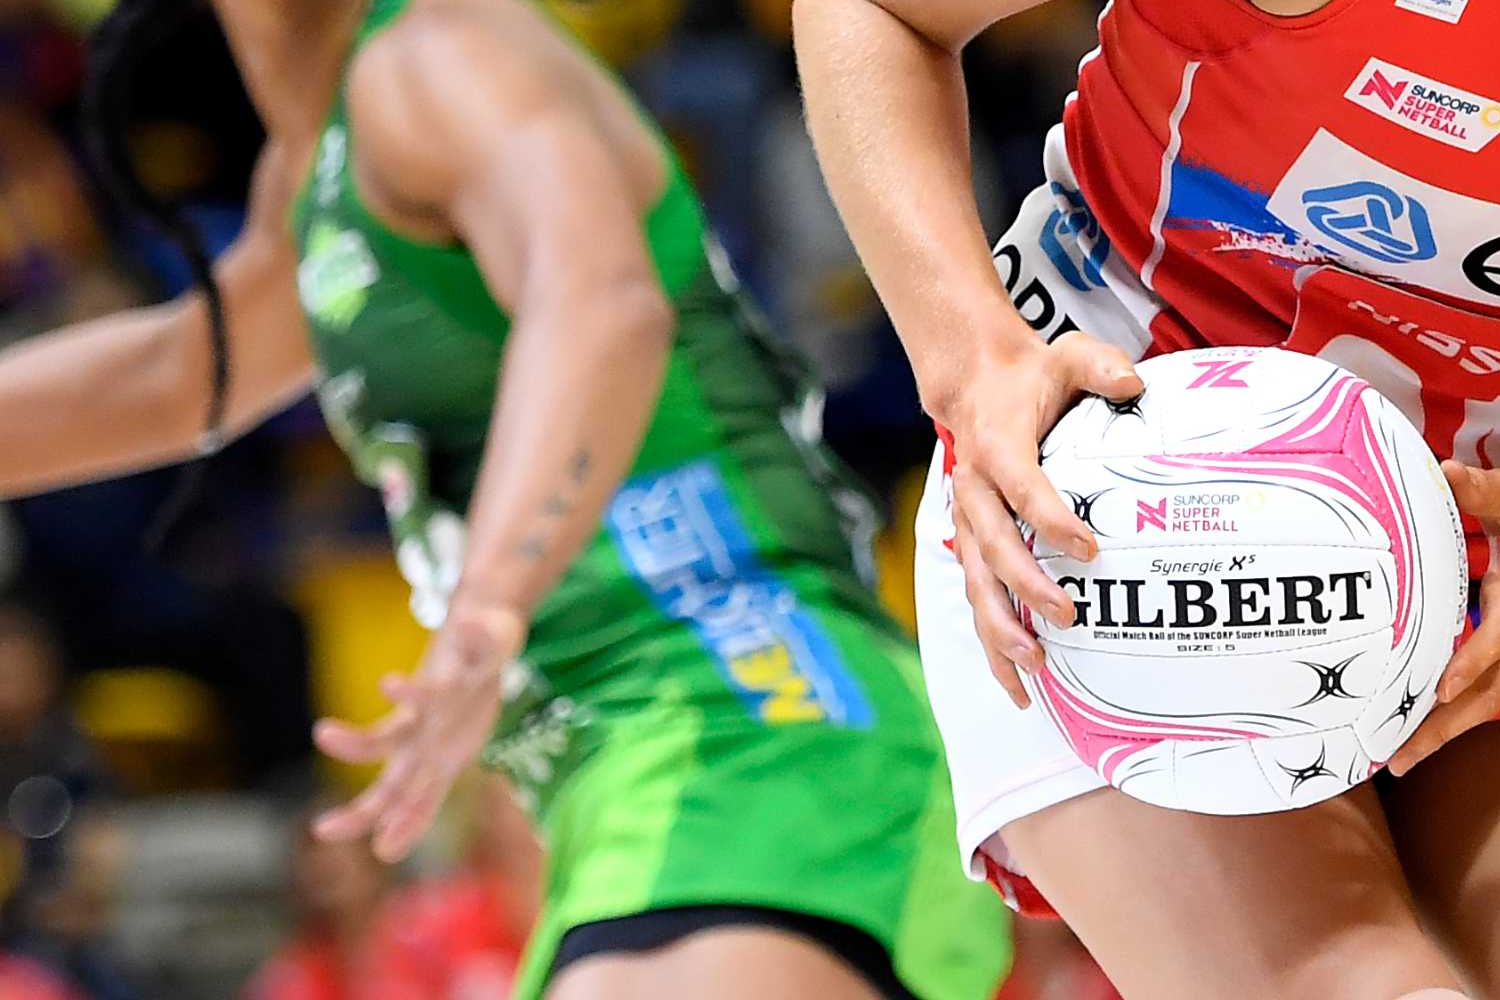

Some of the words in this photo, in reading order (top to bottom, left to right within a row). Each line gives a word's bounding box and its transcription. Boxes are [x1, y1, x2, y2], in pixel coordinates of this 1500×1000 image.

[1404, 95, 1456, 122] SUPER
[1411, 84, 1480, 115] SUNCORP
[1398, 106, 1467, 140] NETBALL
[1173, 494, 1240, 506] SUNCORP
[1172, 507, 1221, 519] SUPER
[1172, 520, 1239, 532] NETBALL
[1150, 559, 1224, 577] Synergie
[1056, 570, 1373, 628] GILBERT
[1193, 631, 1233, 641] SUNCORP
